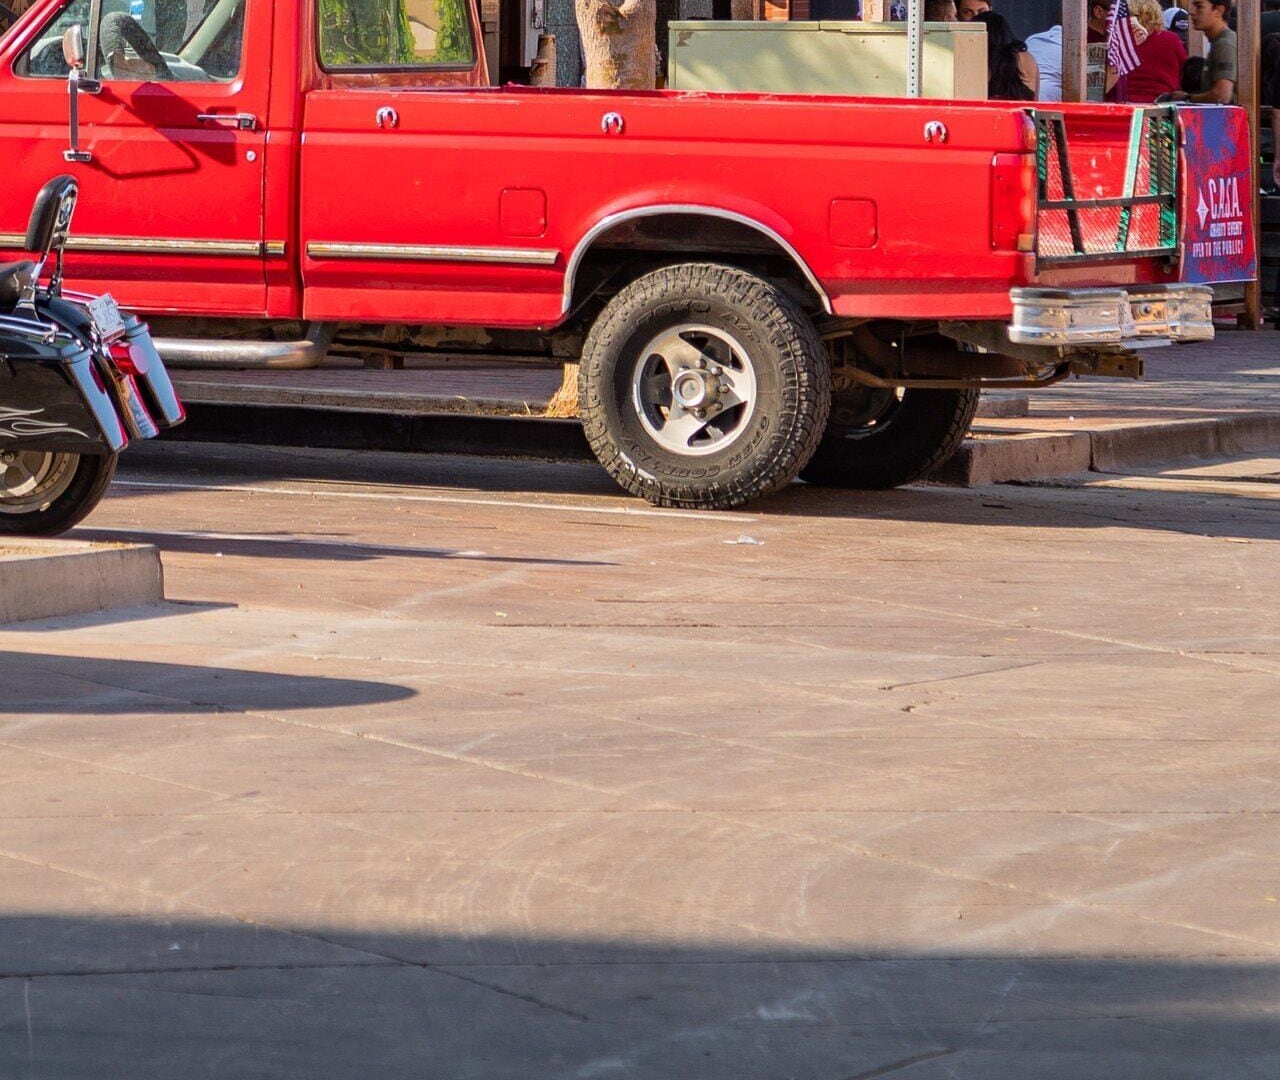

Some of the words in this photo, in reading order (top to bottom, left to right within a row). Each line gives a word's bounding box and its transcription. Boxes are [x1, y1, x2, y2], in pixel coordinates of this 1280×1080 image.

[1192, 242, 1204, 258] OPEN
[1205, 242, 1212, 257] TO
[1213, 241, 1221, 257] THE
[1222, 239, 1244, 256] PUBLIC!
